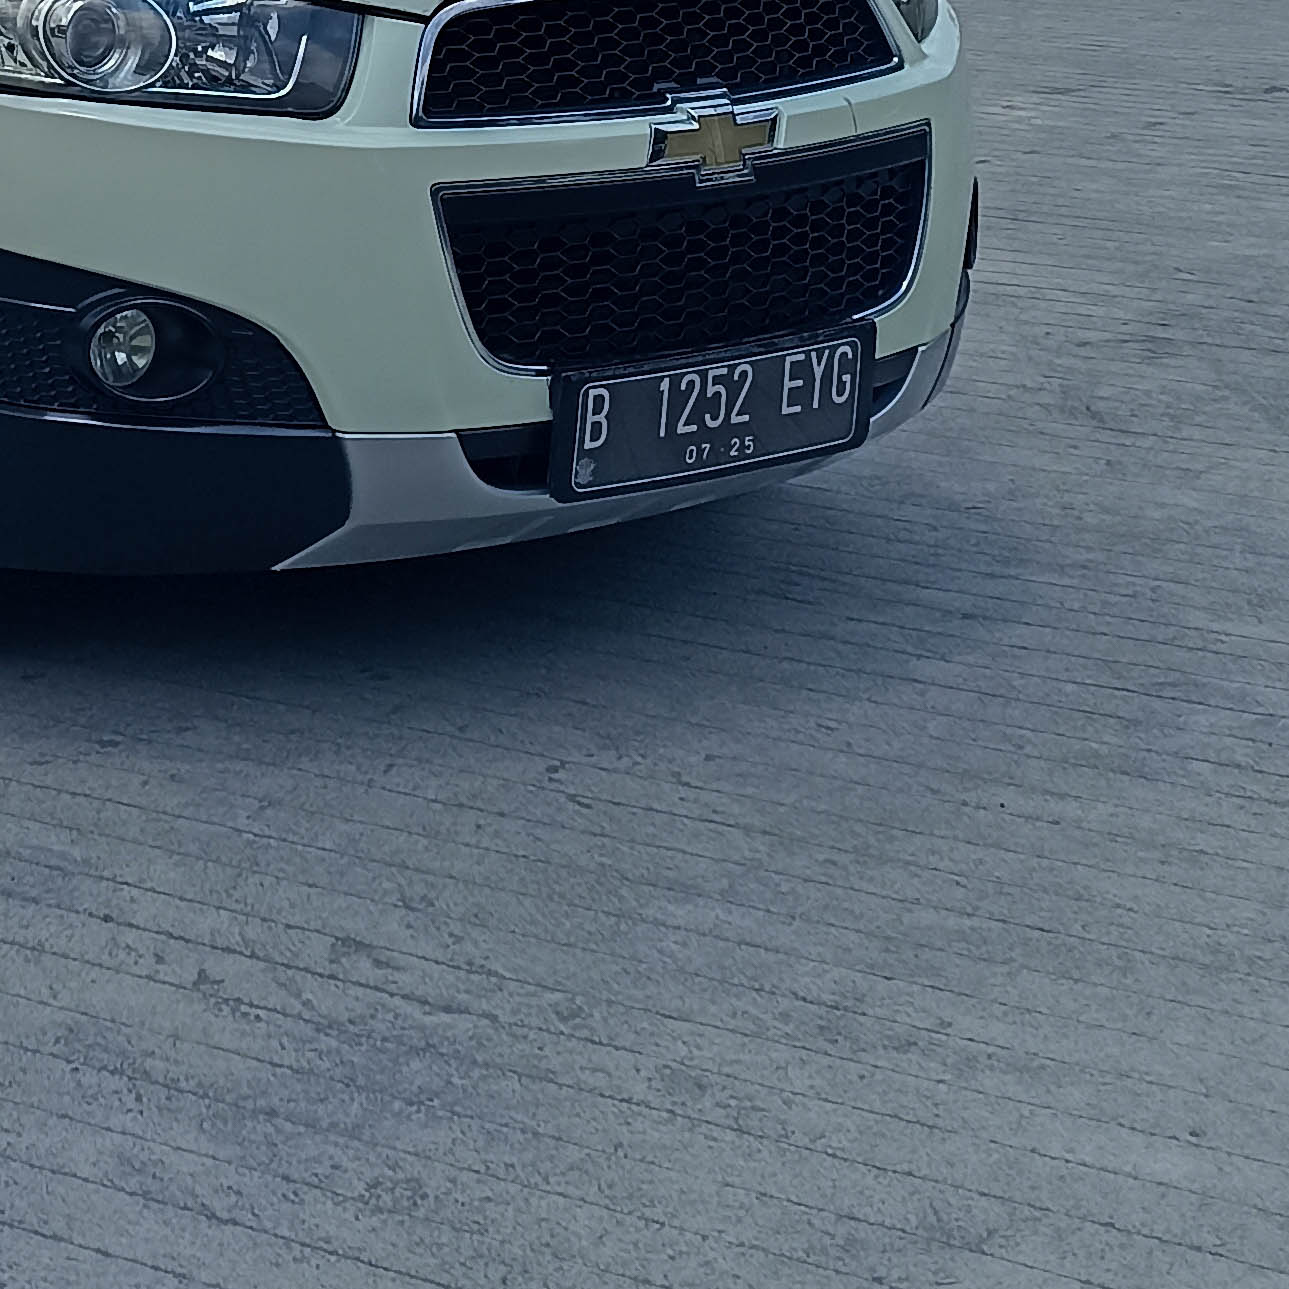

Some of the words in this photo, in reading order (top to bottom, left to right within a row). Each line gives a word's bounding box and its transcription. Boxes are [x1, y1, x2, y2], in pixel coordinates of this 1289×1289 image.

[583, 387, 610, 450] B
[658, 363, 754, 438] 1252
[781, 345, 853, 415] EYG
